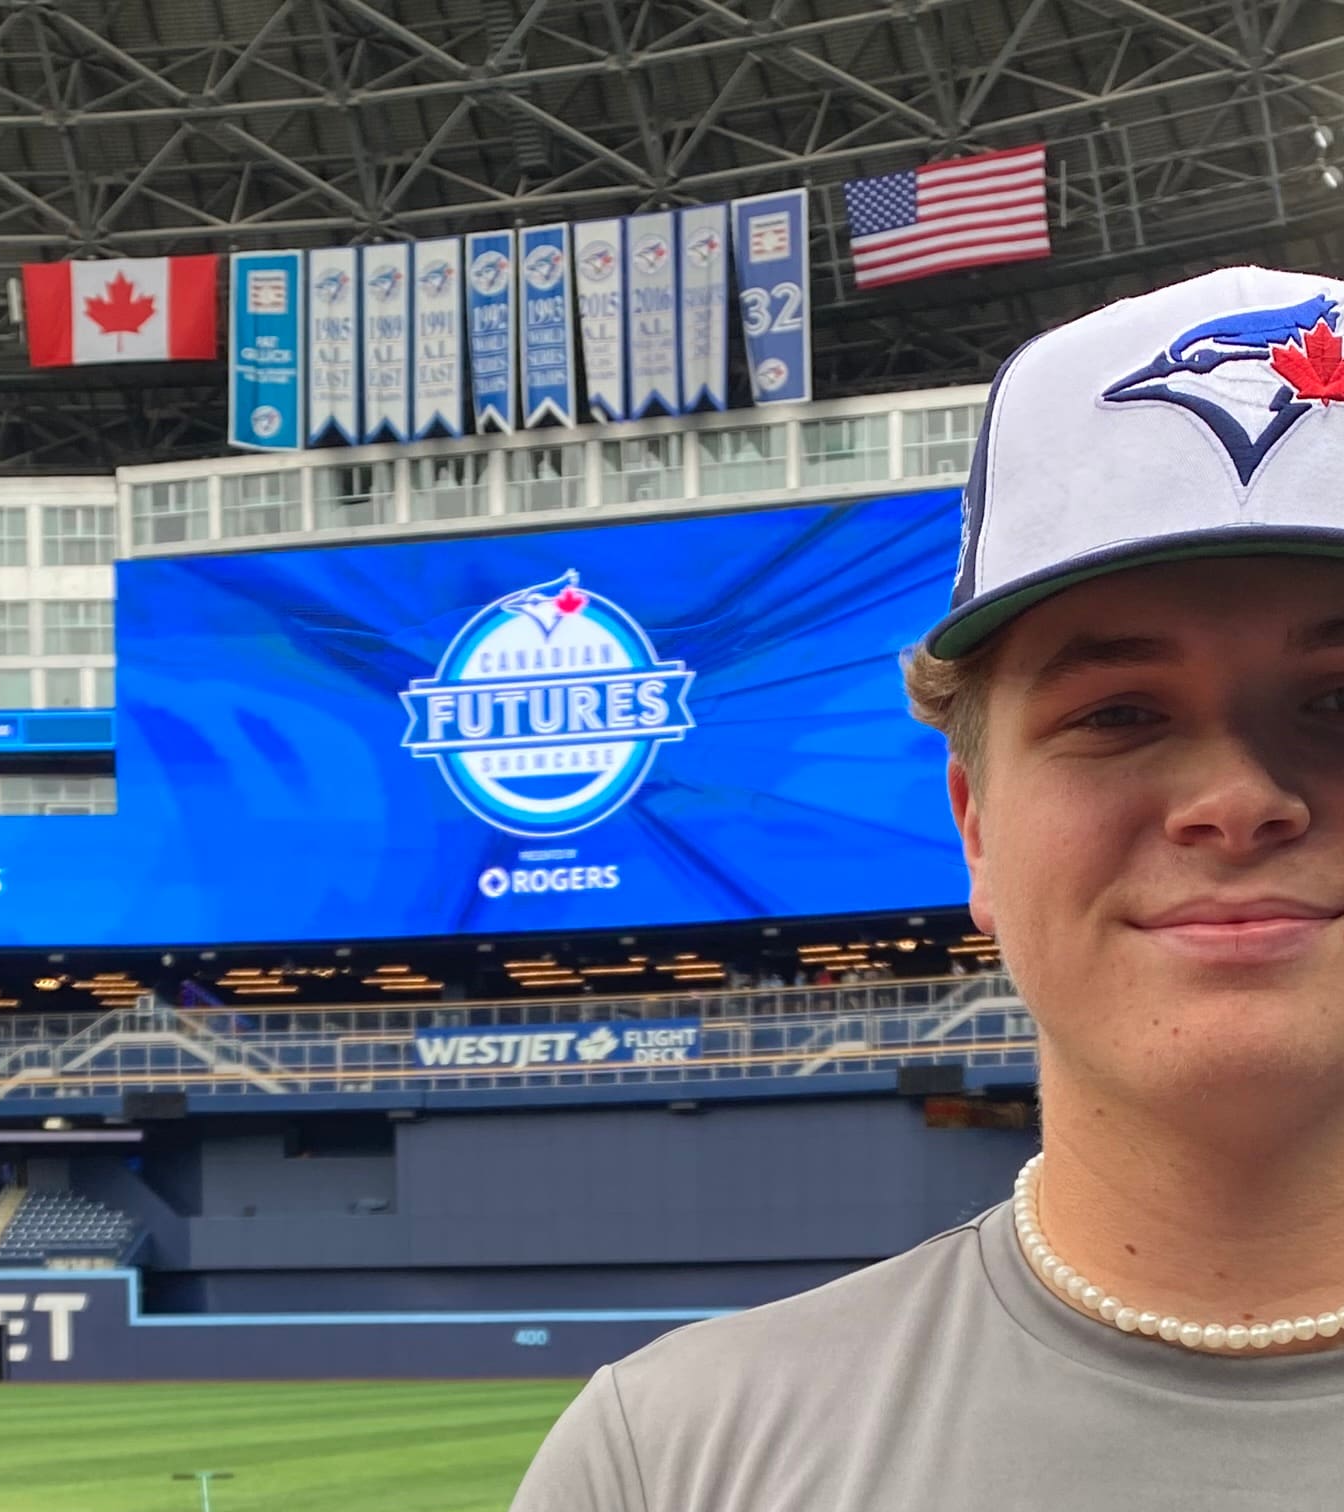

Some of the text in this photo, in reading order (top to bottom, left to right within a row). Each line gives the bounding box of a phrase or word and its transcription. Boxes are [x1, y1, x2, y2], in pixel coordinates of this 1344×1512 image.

[528, 296, 563, 325] 1993
[739, 281, 802, 336] 32
[420, 311, 454, 336] 1991
[479, 642, 614, 673] CANADIAN
[427, 679, 670, 741] FUTURES
[479, 748, 616, 774] SHOWCASE
[512, 864, 621, 894] ROGERS
[416, 1032, 577, 1072] WESTJET
[623, 1028, 697, 1048] FLIGHT
[635, 1047, 689, 1064] DECK
[515, 1328, 548, 1346] 400
